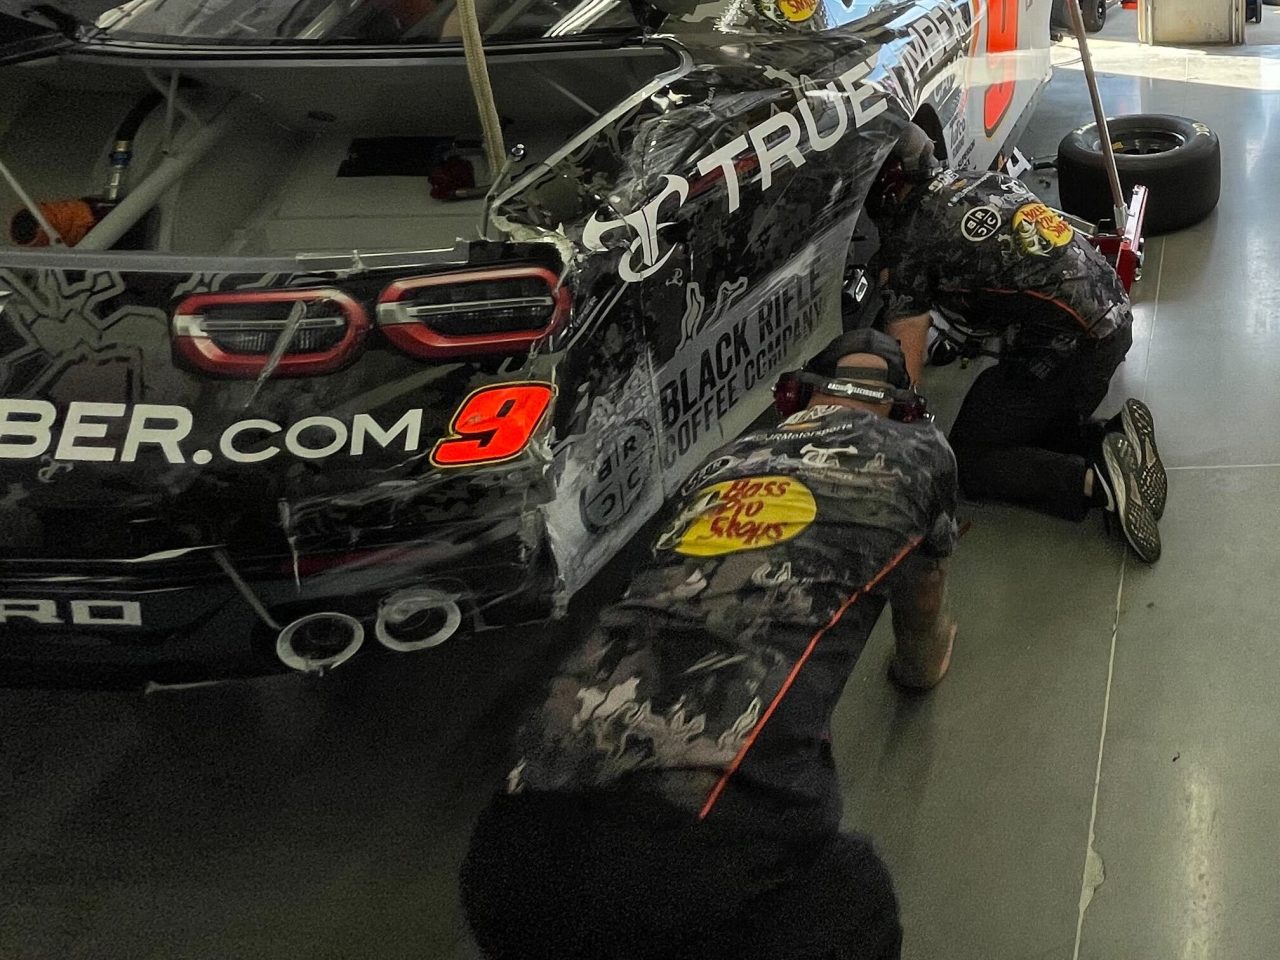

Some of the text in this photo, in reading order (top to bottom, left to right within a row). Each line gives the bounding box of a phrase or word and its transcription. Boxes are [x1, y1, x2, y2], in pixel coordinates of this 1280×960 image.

[660, 317, 751, 430] BLACK
[429, 380, 559, 469] 9
[662, 375, 740, 471] COFFEE
[722, 479, 792, 499] Bass
